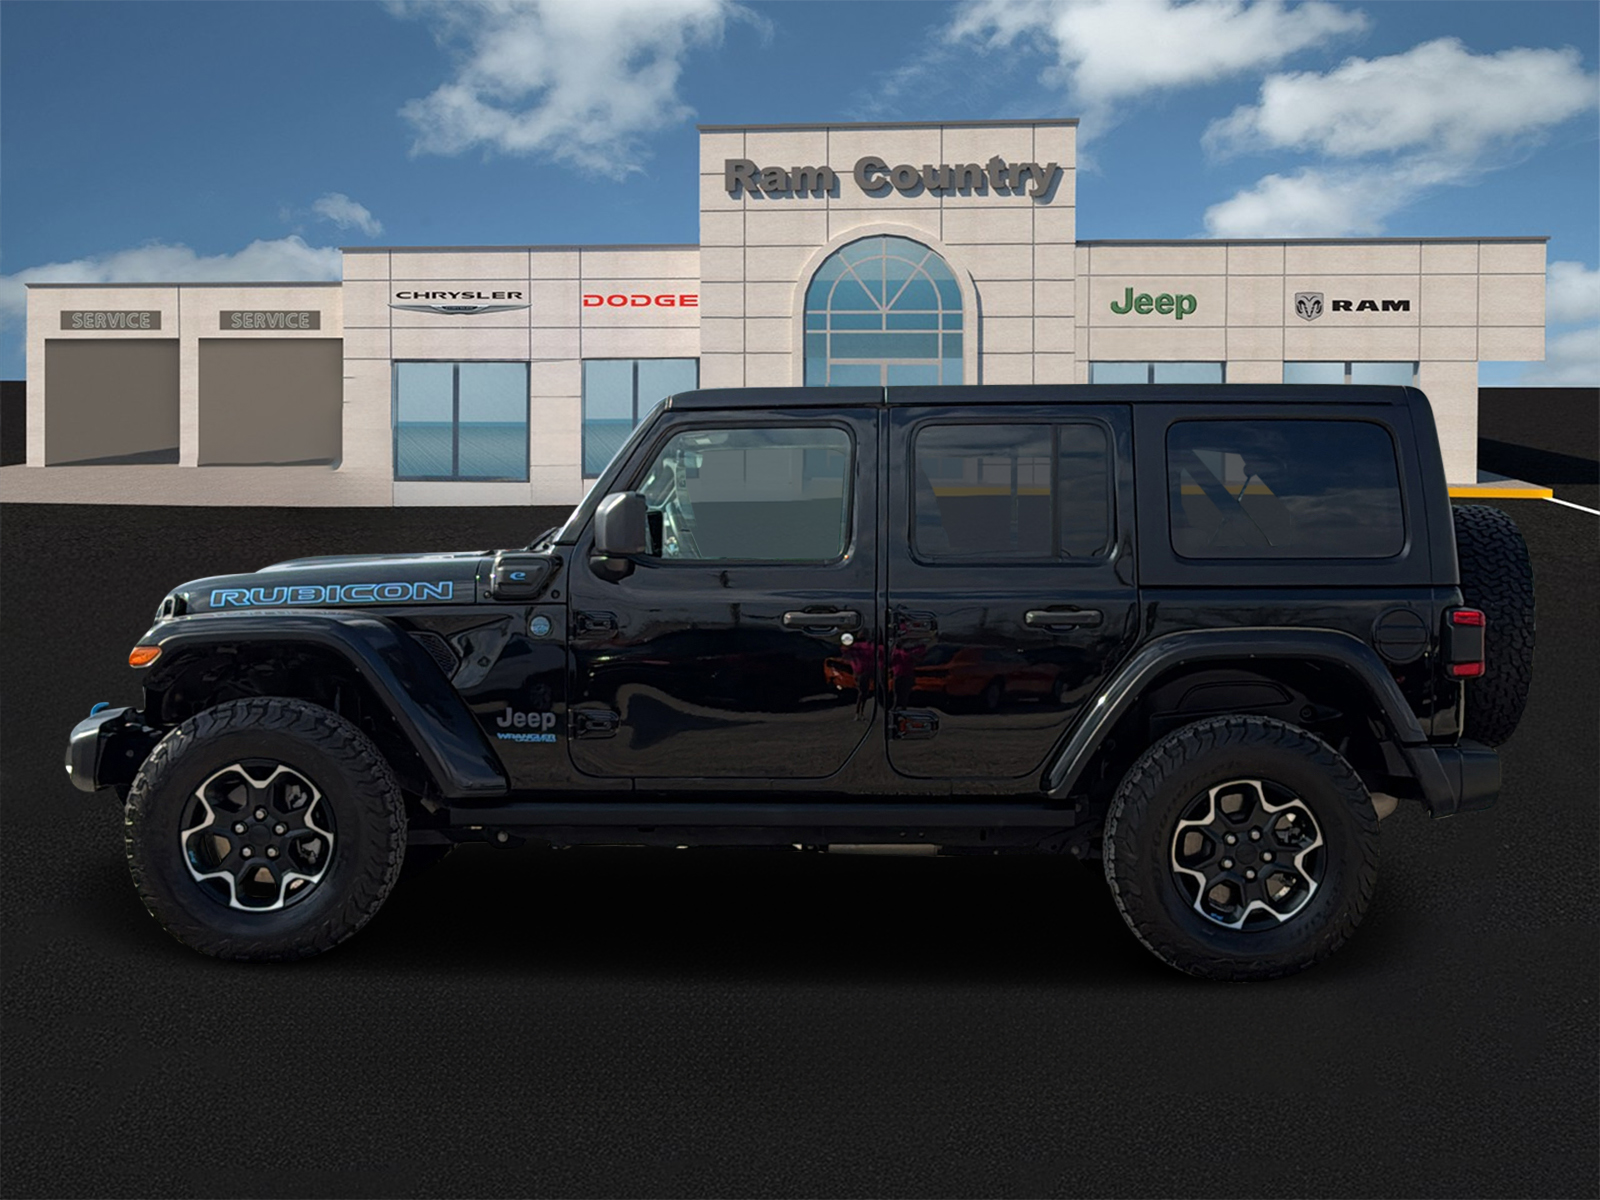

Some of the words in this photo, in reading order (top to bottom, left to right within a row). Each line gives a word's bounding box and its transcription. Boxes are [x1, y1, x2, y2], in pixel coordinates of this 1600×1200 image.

[724, 159, 834, 192] Ram
[853, 154, 1058, 198] Country
[395, 291, 523, 300] CHRYSLER
[583, 294, 699, 307] DODGE
[1110, 287, 1198, 321] Jeep
[1331, 299, 1411, 312] RAM
[71, 312, 151, 329] SERVICE
[230, 312, 310, 329] SERVICE
[209, 581, 453, 608] RUBICON
[496, 706, 557, 732] Jeep
